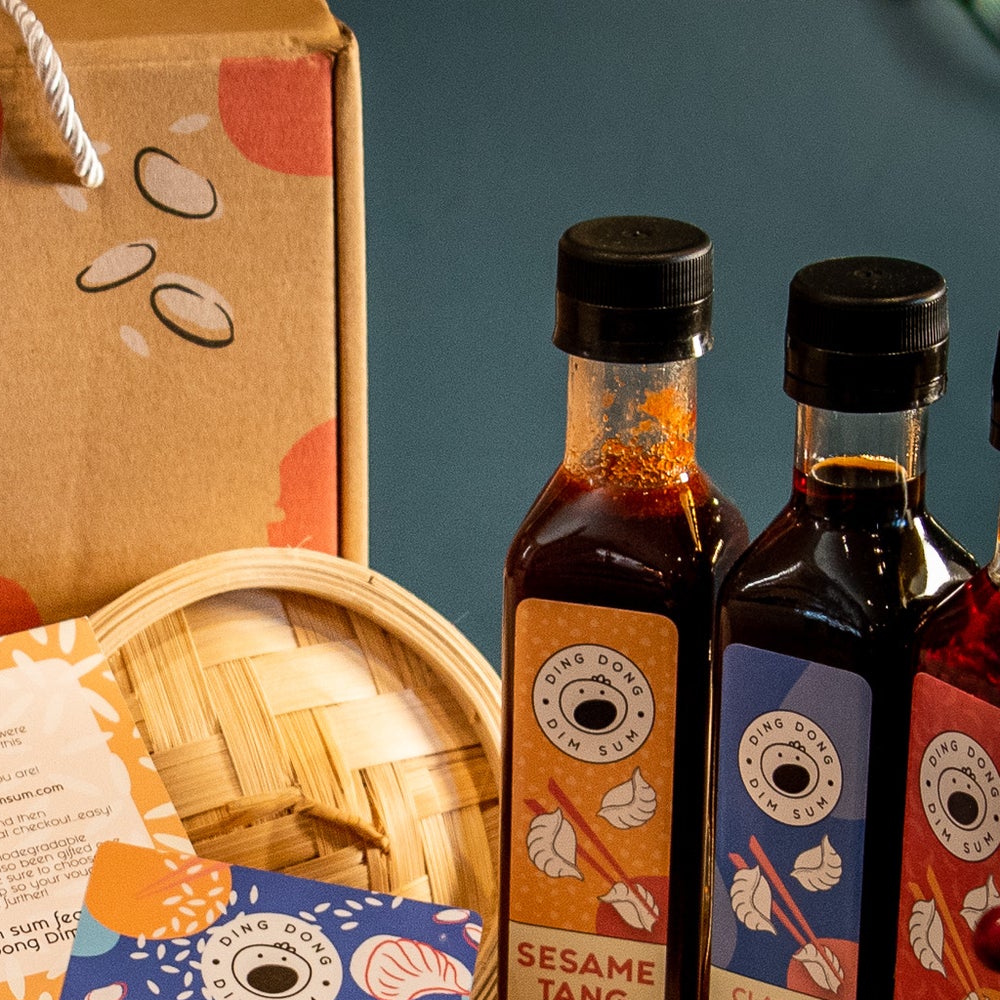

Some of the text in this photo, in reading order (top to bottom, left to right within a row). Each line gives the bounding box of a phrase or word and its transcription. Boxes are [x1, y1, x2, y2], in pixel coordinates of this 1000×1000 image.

[545, 653, 643, 696] DING DONG
[1, 737, 22, 749] this
[547, 719, 639, 756] DIM SUM
[749, 718, 833, 765] DING DONG
[929, 740, 999, 797] DING DONG
[18, 810, 46, 823] then
[750, 779, 828, 819] DIM SUM
[928, 803, 994, 853] DIM SUM
[6, 871, 34, 883] sure
[37, 865, 50, 875] to
[54, 854, 95, 871] choos
[20, 854, 54, 868] been
[57, 843, 93, 861] gifted
[10, 883, 26, 893] so
[30, 876, 60, 890] your
[10, 919, 50, 937] sum
[45, 927, 78, 945] Dim
[219, 920, 332, 965] DING DONG
[517, 941, 655, 986] SESAME
